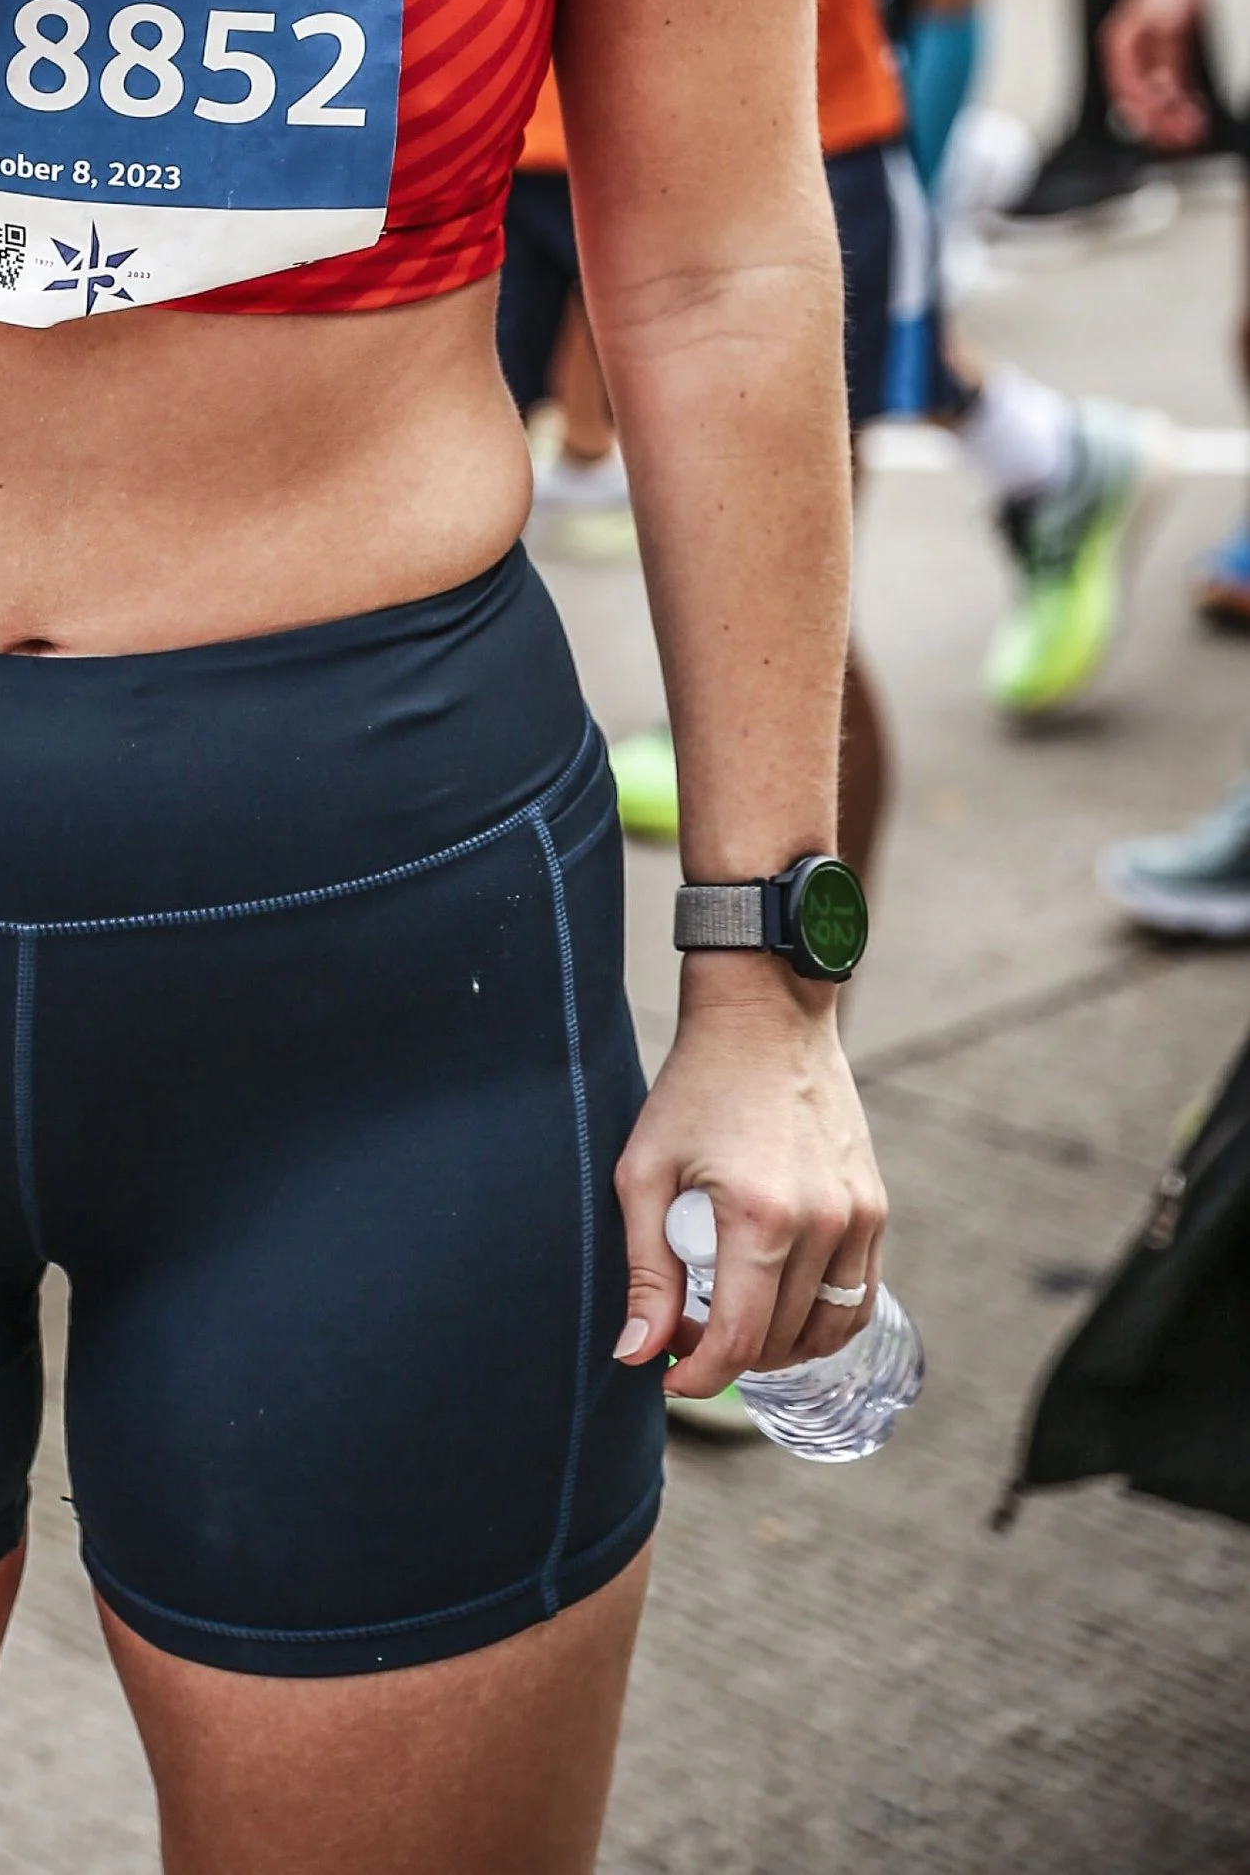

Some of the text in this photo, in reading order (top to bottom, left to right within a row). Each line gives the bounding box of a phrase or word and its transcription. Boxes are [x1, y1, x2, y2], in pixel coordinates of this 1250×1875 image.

[72, 160, 98, 189] 8,
[108, 162, 182, 191] 2023
[127, 270, 151, 279] 2023
